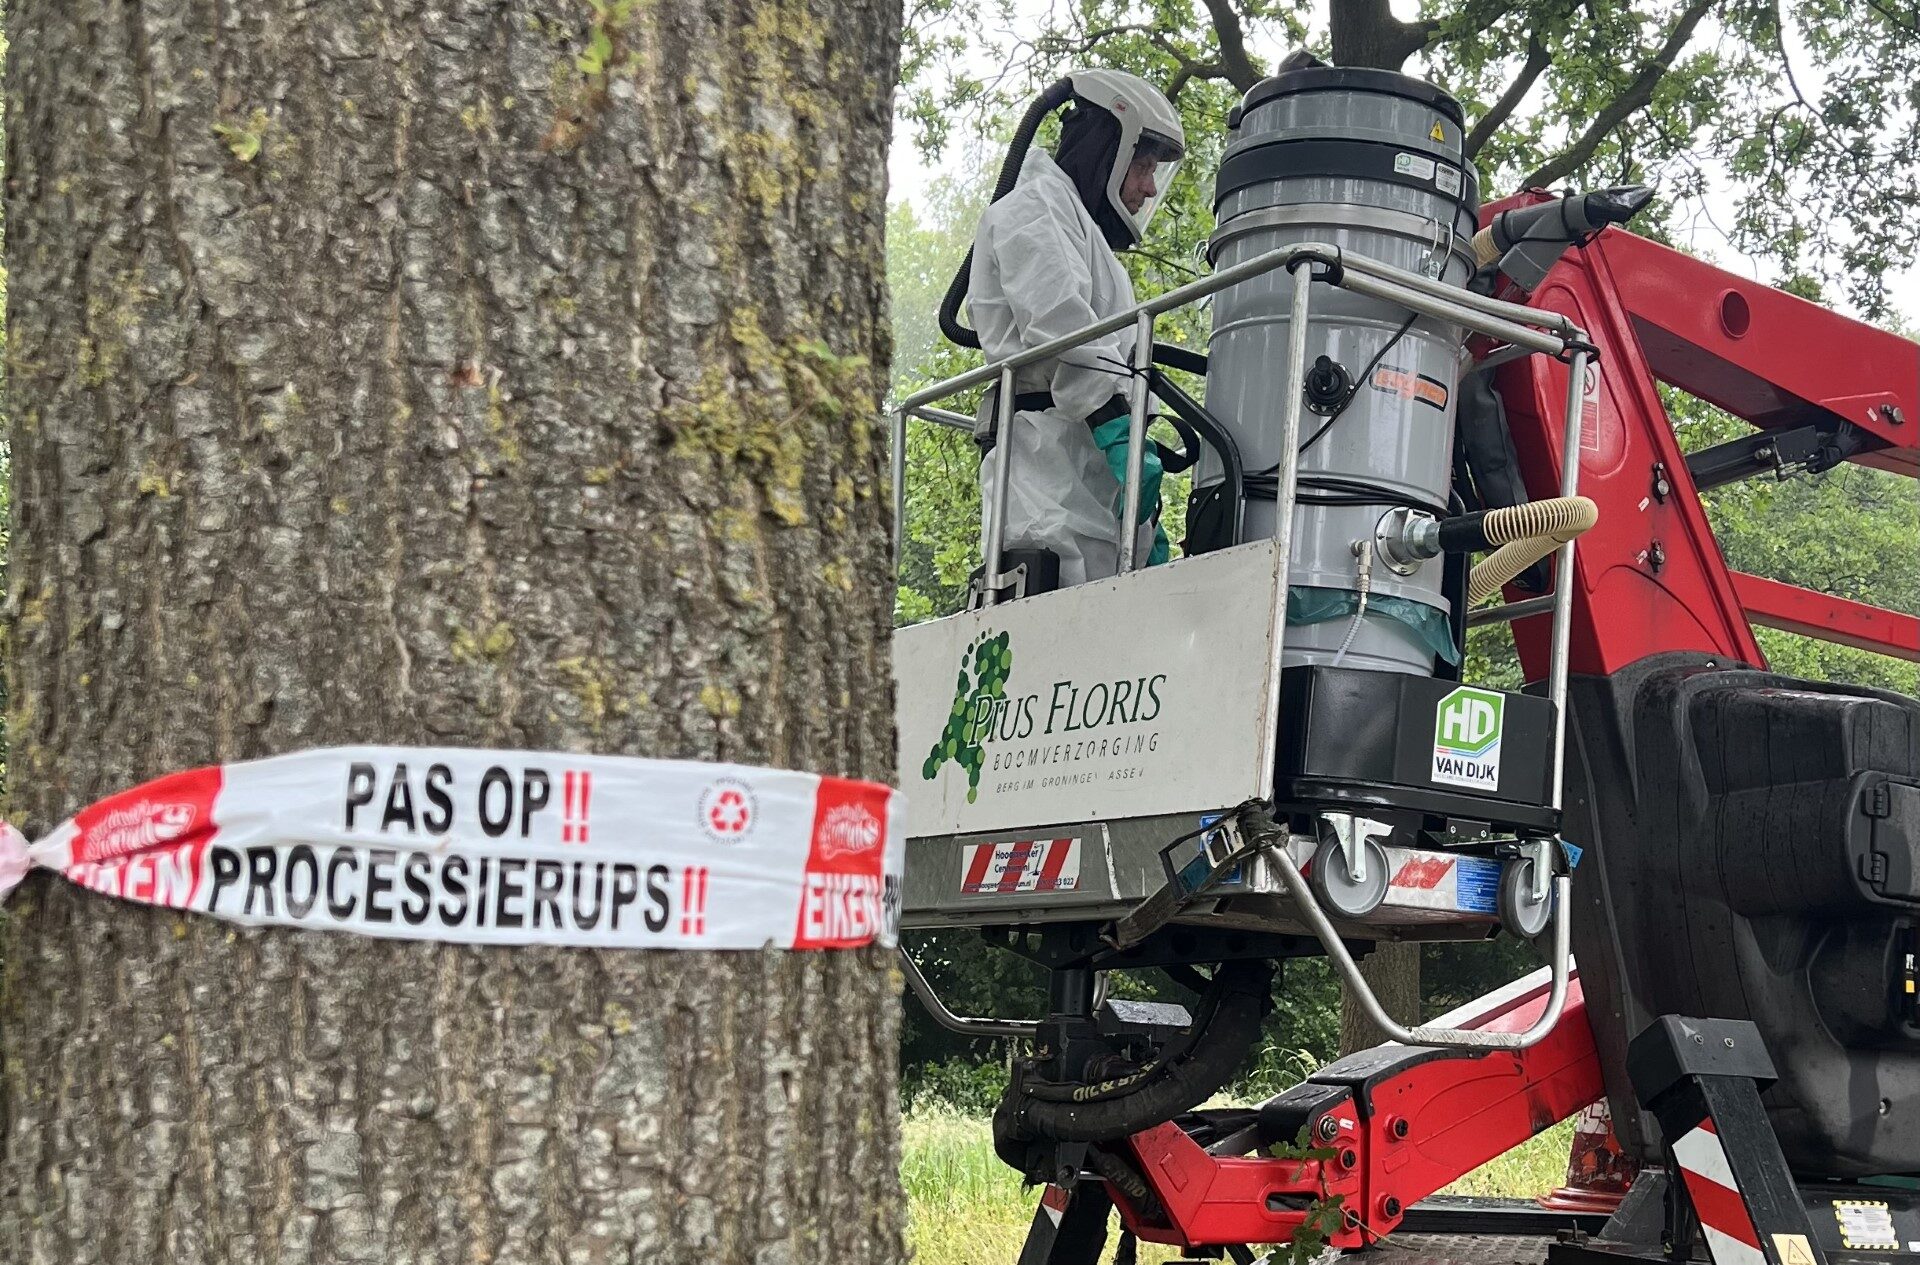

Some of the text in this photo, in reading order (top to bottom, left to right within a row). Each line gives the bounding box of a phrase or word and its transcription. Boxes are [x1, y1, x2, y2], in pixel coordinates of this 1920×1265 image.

[1044, 674, 1167, 734] FLORIS
[1443, 697, 1496, 744] HD
[993, 733, 1159, 771] BOOMVERZORGING
[1436, 757, 1463, 776] VAN
[1467, 762, 1496, 782] DIJK
[345, 761, 453, 836] PAS
[1041, 772, 1098, 788] GRONINGE
[803, 872, 880, 939] EIKEN
[1073, 1085, 1100, 1102] OIL
